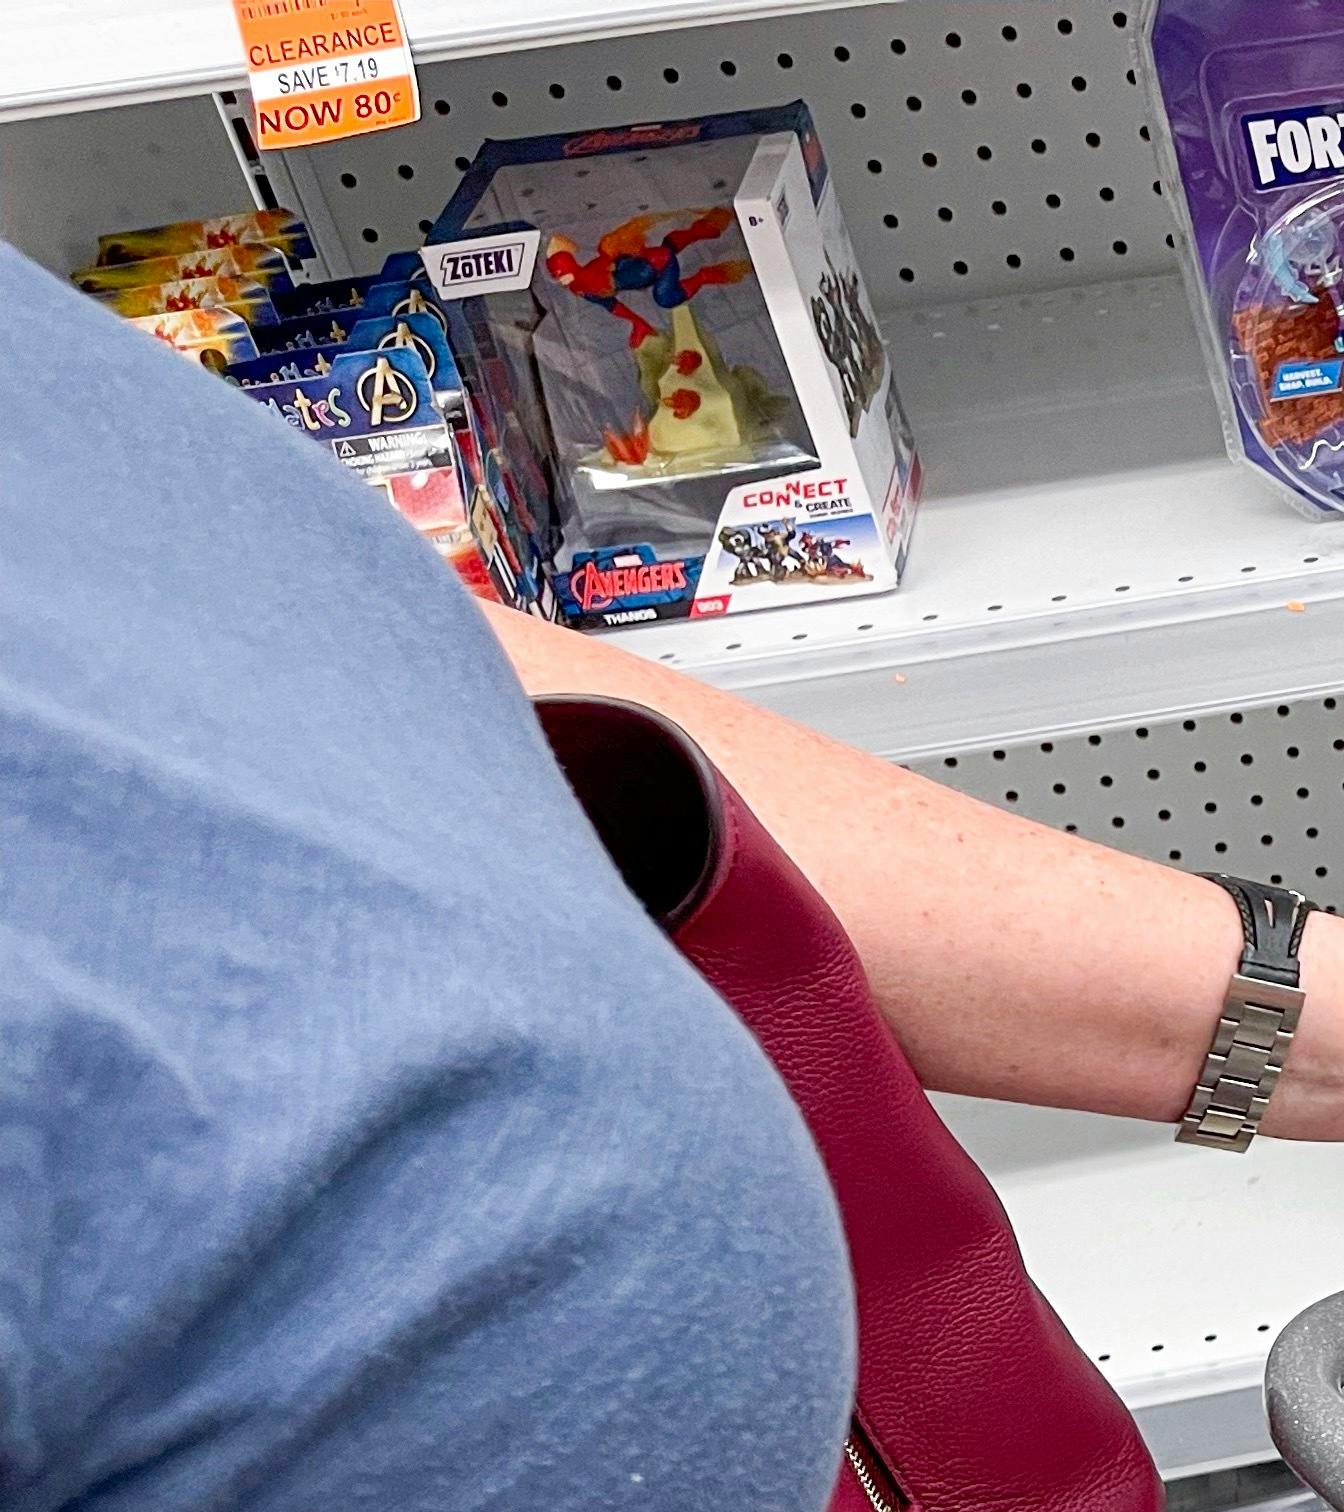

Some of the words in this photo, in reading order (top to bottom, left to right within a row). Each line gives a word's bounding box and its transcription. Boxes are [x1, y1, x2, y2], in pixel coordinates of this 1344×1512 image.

[250, 22, 396, 66] CLEARANCE
[278, 66, 330, 94] SAVE
[260, 98, 342, 134] NOW
[742, 478, 848, 508] CONNECT
[805, 497, 852, 512] CREATE
[569, 560, 688, 611] AVENGERS
[603, 608, 658, 626] THANOS
